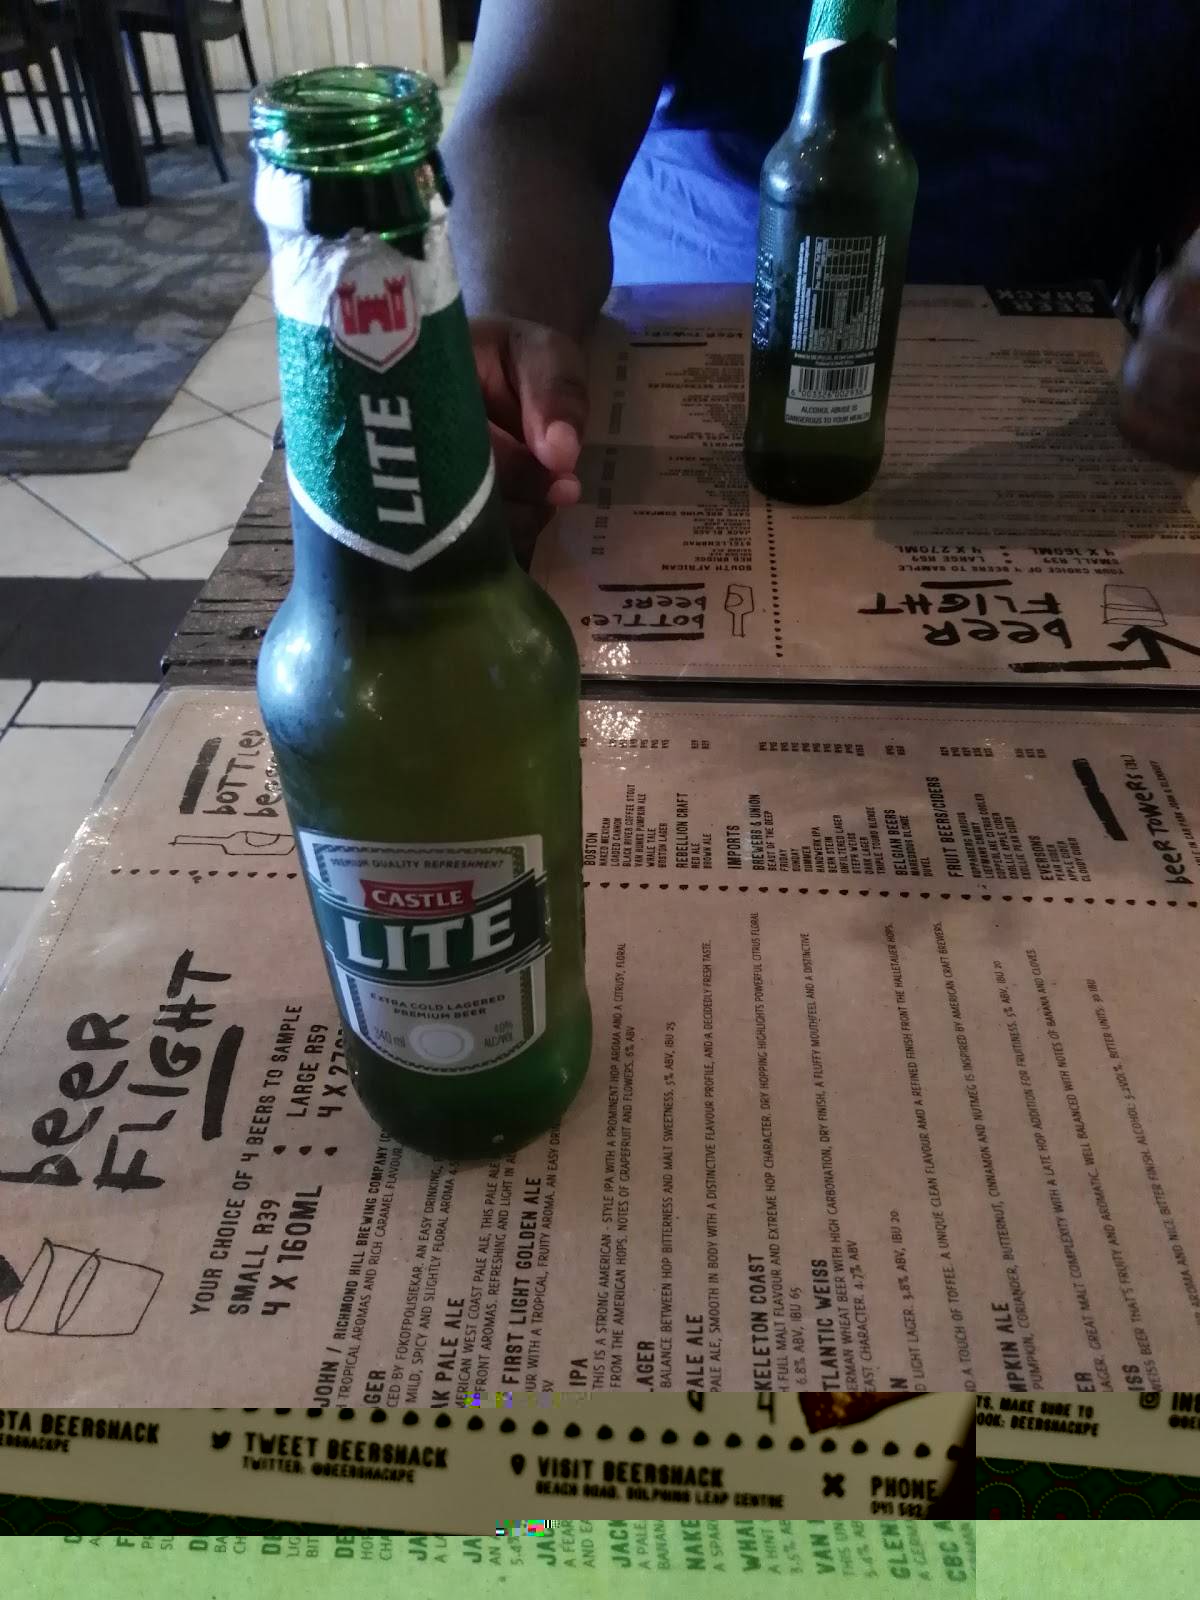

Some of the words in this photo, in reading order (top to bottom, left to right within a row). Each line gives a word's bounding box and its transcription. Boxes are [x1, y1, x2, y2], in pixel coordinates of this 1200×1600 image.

[360, 393, 426, 526] LITE
[857, 592, 1062, 616] FLIGHT
[676, 792, 688, 818] CRAFT
[749, 794, 761, 818] UNION
[884, 809, 900, 835] BEERS
[927, 776, 954, 842] BEERS/CIDERS
[584, 832, 597, 865] BOSTON
[676, 820, 688, 868] REBELLION
[726, 825, 741, 869] IMPORTS
[750, 829, 764, 870] BREWERS
[889, 838, 908, 875] BELGIAN
[942, 847, 963, 878] FRUIT
[372, 859, 419, 870] QUALITY
[424, 859, 504, 869] REFRESHMENT
[371, 889, 464, 908] CASTLE
[342, 898, 516, 971] LITE
[940, 956, 952, 978] CRAFT
[370, 992, 406, 1008] EXTRA
[410, 1003, 444, 1011] COLD
[447, 994, 506, 1010] LAGERED
[394, 1008, 450, 1019] PREMIUM
[454, 1008, 487, 1018] BEER
[946, 980, 961, 1020] AMERICAN
[270, 1005, 301, 1062] SAMPLE
[664, 1033, 674, 1048] IBU
[954, 1021, 965, 1032] BY
[664, 1050, 675, 1070] ABV,
[957, 1033, 972, 1070] INSPIRED
[93, 950, 232, 1192] FLIGHT
[262, 1069, 282, 1088] TO
[286, 1061, 319, 1117] LARGE
[304, 1024, 327, 1054] R59
[965, 1073, 975, 1081] IS
[321, 1084, 347, 1097] X
[967, 1084, 983, 1120] NUTMEG
[245, 1095, 274, 1145] BEERS
[317, 1106, 343, 1118] 4
[662, 1088, 673, 1142] SWEETNESS.
[975, 1123, 988, 1143] AND
[240, 1152, 258, 1162] 4
[368, 1146, 387, 1194] COMPANY
[662, 1145, 672, 1170] MALT
[980, 1146, 1000, 1197] CINNAMON
[231, 1169, 252, 1190] OF
[523, 1177, 541, 1204] ALE
[662, 1173, 673, 1194] AND
[209, 1198, 244, 1260] CHOICE
[277, 1185, 321, 1263] 160ML
[355, 1197, 376, 1246] BREWING
[374, 1194, 391, 1238] CARAMEL
[661, 1196, 672, 1253] BITTERNESS
[889, 1209, 900, 1223] 20
[891, 1225, 902, 1243] IBU
[994, 1200, 1014, 1260] BUTTERNUT,
[229, 1244, 267, 1314] SMALL
[251, 1199, 279, 1234] R39
[368, 1241, 382, 1265] RICH
[515, 1210, 536, 1269] GOLDEN
[348, 1251, 365, 1275] HILL
[661, 1257, 672, 1278] HOP
[895, 1247, 907, 1272] ABV,
[191, 1268, 222, 1314] YOUR
[268, 1274, 298, 1290] X
[362, 1268, 376, 1291] AND
[748, 1253, 766, 1304] COAST
[811, 1259, 831, 1309] WEISS
[1008, 1264, 1029, 1328] CORIANDER,
[261, 1301, 290, 1315] 4
[333, 1280, 358, 1339] RICHMOND
[352, 1294, 371, 1340] AROMAS
[444, 1297, 464, 1329] ALE
[508, 1276, 529, 1324] LIGHT
[660, 1280, 672, 1332] BETWEEN
[992, 1302, 1014, 1334] ALE
[685, 1314, 703, 1346] ALE
[903, 1304, 918, 1343] LAGER.
[435, 1336, 458, 1381] PALE
[501, 1332, 523, 1384] FIRST
[636, 1340, 654, 1392] AGER
[659, 1336, 672, 1388] BALANCE
[751, 1311, 771, 1391] KELETON
[816, 1318, 839, 1392] TLANTIC
[908, 1346, 924, 1378] LIGHT
[313, 1361, 339, 1408] JOHN
[338, 1344, 360, 1398] TROPICAL
[362, 1370, 386, 1408] GER
[568, 1358, 587, 1386] IPA
[685, 1354, 704, 1392] ALE
[245, 1432, 318, 1457] TWEET
[327, 1438, 448, 1468] BEERSHACK
[538, 1456, 594, 1480] VISIT
[603, 1460, 723, 1488] BEERSHACK
[870, 1475, 938, 1500] PHONE
[814, 1533, 836, 1576] VAN
